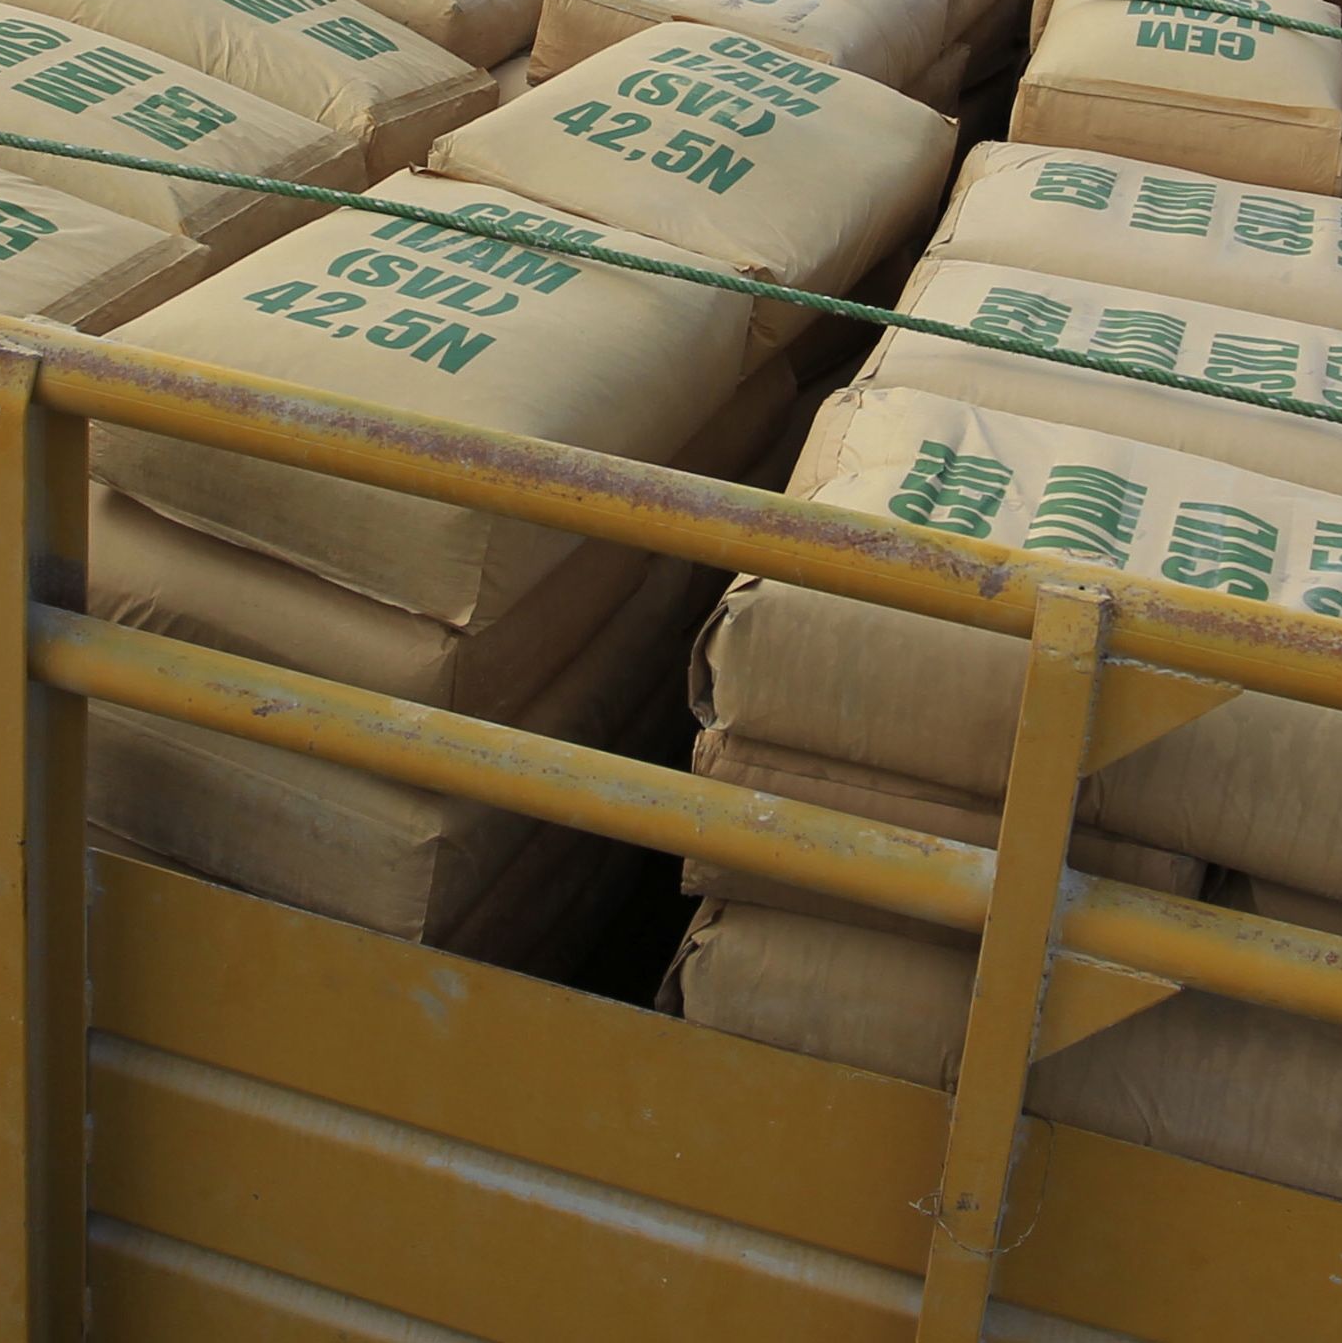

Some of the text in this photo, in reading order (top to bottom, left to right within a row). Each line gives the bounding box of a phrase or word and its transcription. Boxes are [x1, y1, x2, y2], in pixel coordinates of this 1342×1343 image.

[302, 16, 400, 61] CEM
[709, 36, 841, 94] CEM
[1136, 20, 1256, 61] CEM
[12, 46, 164, 113] II/AM
[617, 69, 776, 137] (SVL)
[649, 47, 822, 117] II/AM
[113, 85, 238, 150] CEM
[553, 100, 755, 195] 42,5N
[1030, 162, 1118, 210] CEM
[1233, 194, 1316, 255] (SVL)
[327, 248, 520, 318] (SVL)
[243, 280, 497, 375] 42,5N
[971, 287, 1072, 349] CEM
[1203, 333, 1300, 397] SVL)
[889, 440, 1014, 539] CEM
[1161, 501, 1279, 602] SVL)
